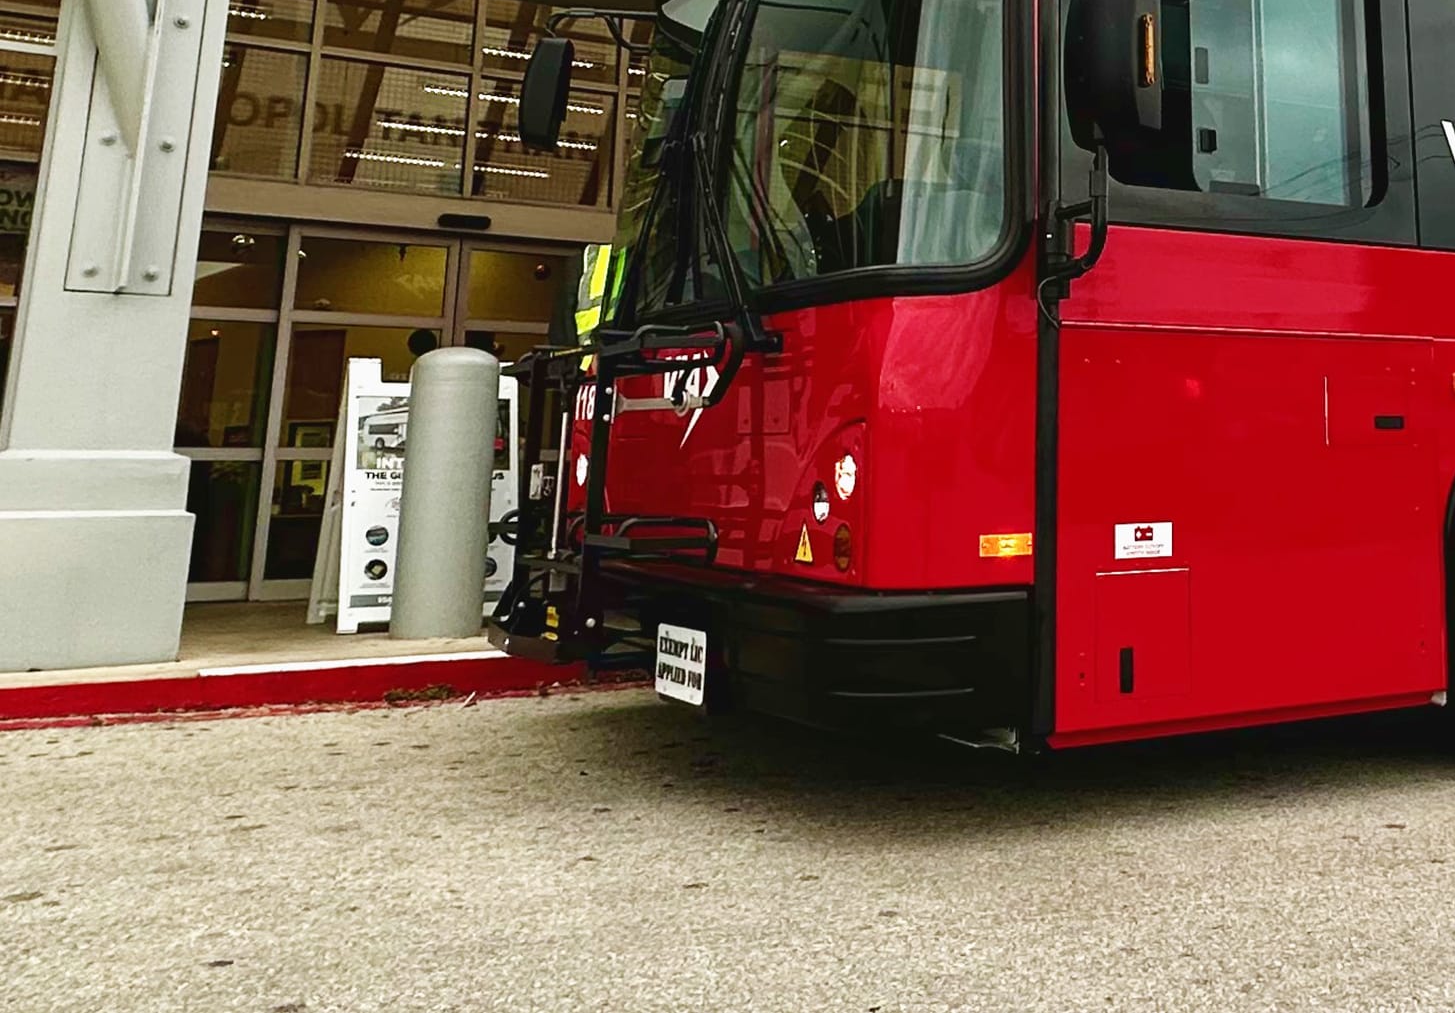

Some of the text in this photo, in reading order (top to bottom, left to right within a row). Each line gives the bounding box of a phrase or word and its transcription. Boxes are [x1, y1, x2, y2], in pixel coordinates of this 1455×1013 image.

[663, 351, 702, 401] VA
[575, 384, 597, 421] 118
[365, 471, 388, 480] THE
[660, 636, 689, 660] EXEMPT
[658, 662, 686, 685] APPLIED
